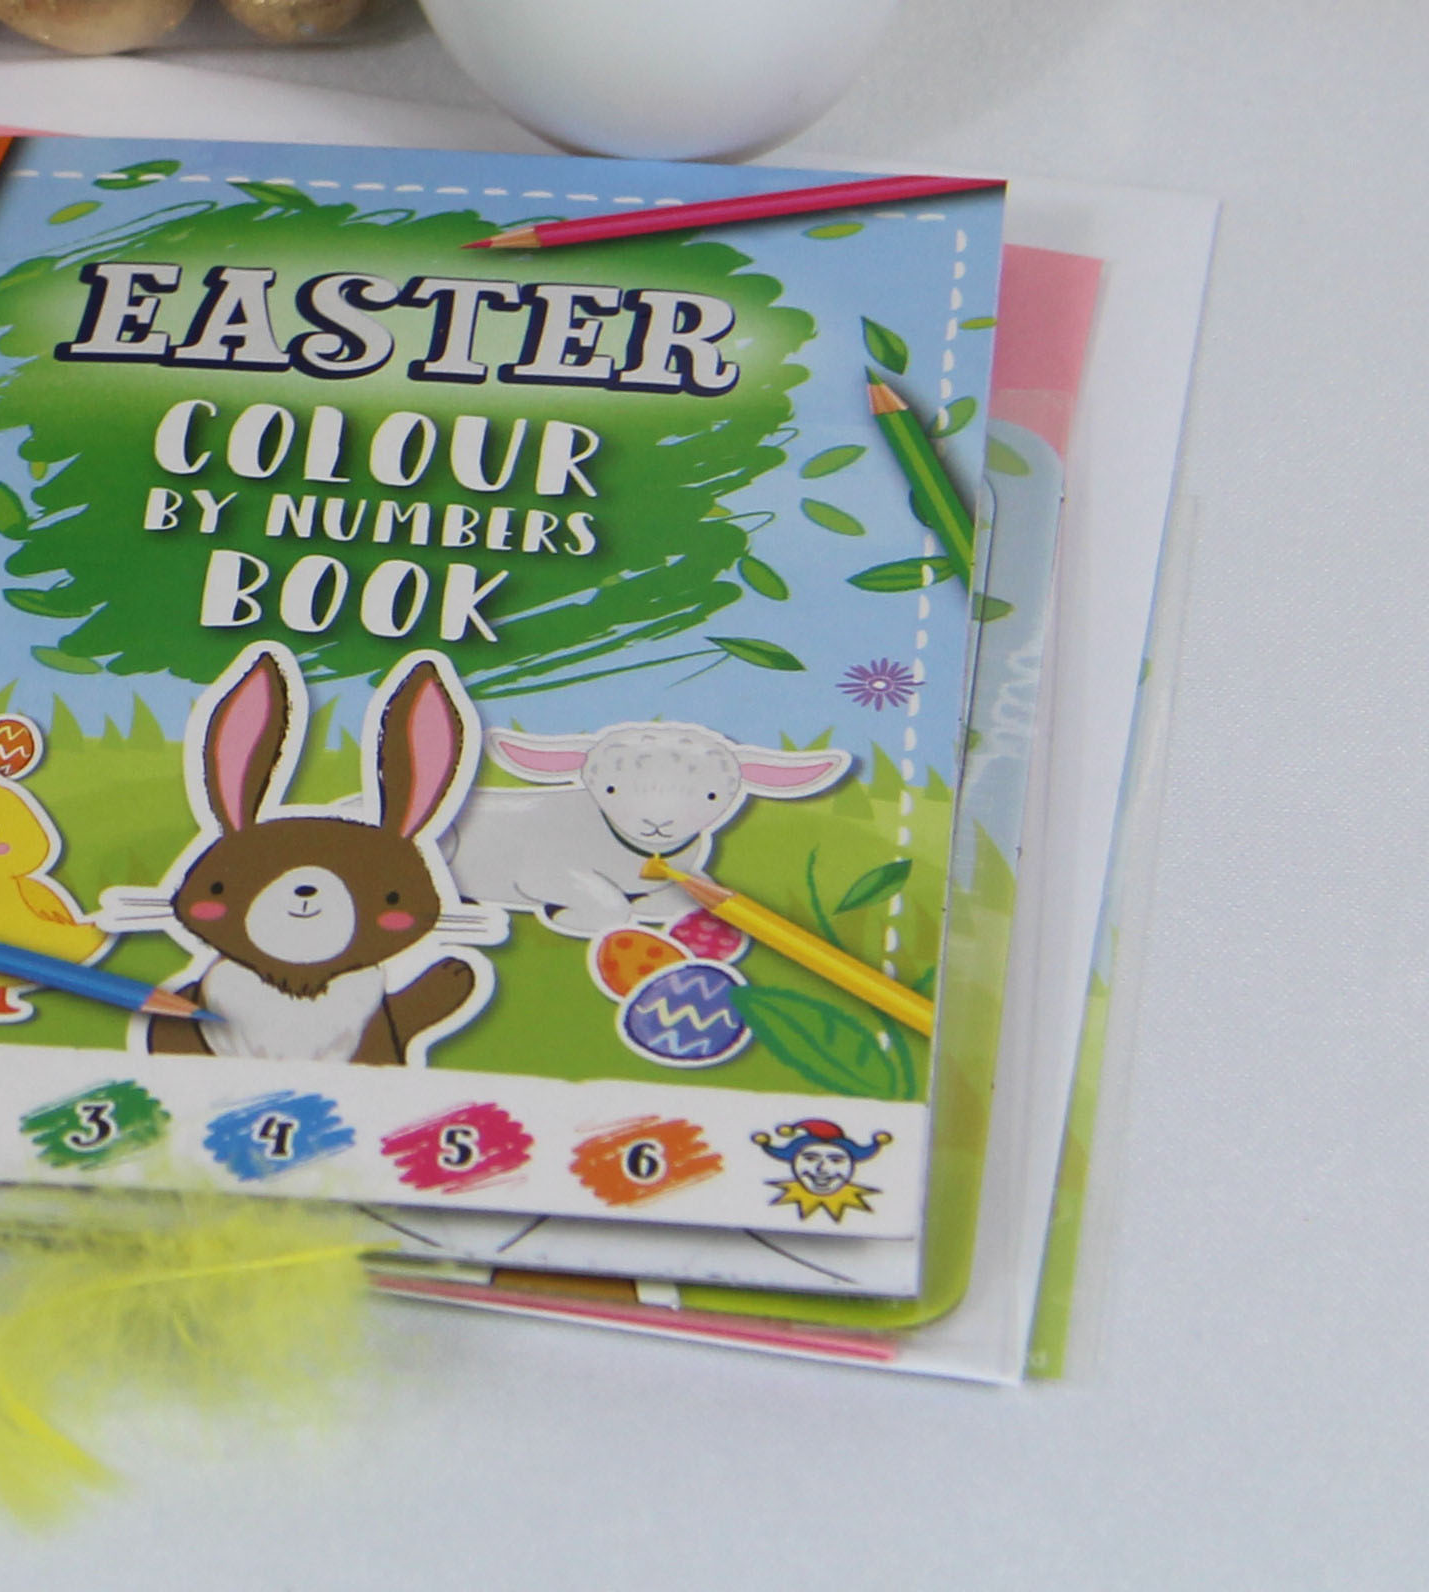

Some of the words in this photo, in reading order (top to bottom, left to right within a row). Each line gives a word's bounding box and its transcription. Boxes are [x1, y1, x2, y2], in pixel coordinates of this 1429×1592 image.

[54, 261, 741, 395] EASTER
[153, 399, 600, 499] COLOUR
[143, 486, 238, 534] BY
[264, 493, 597, 556] NUMBERS
[198, 549, 511, 643] BOOK
[69, 1101, 116, 1151] 3
[256, 1112, 298, 1160] 4
[440, 1126, 478, 1170] 5
[623, 1139, 667, 1182] 6
